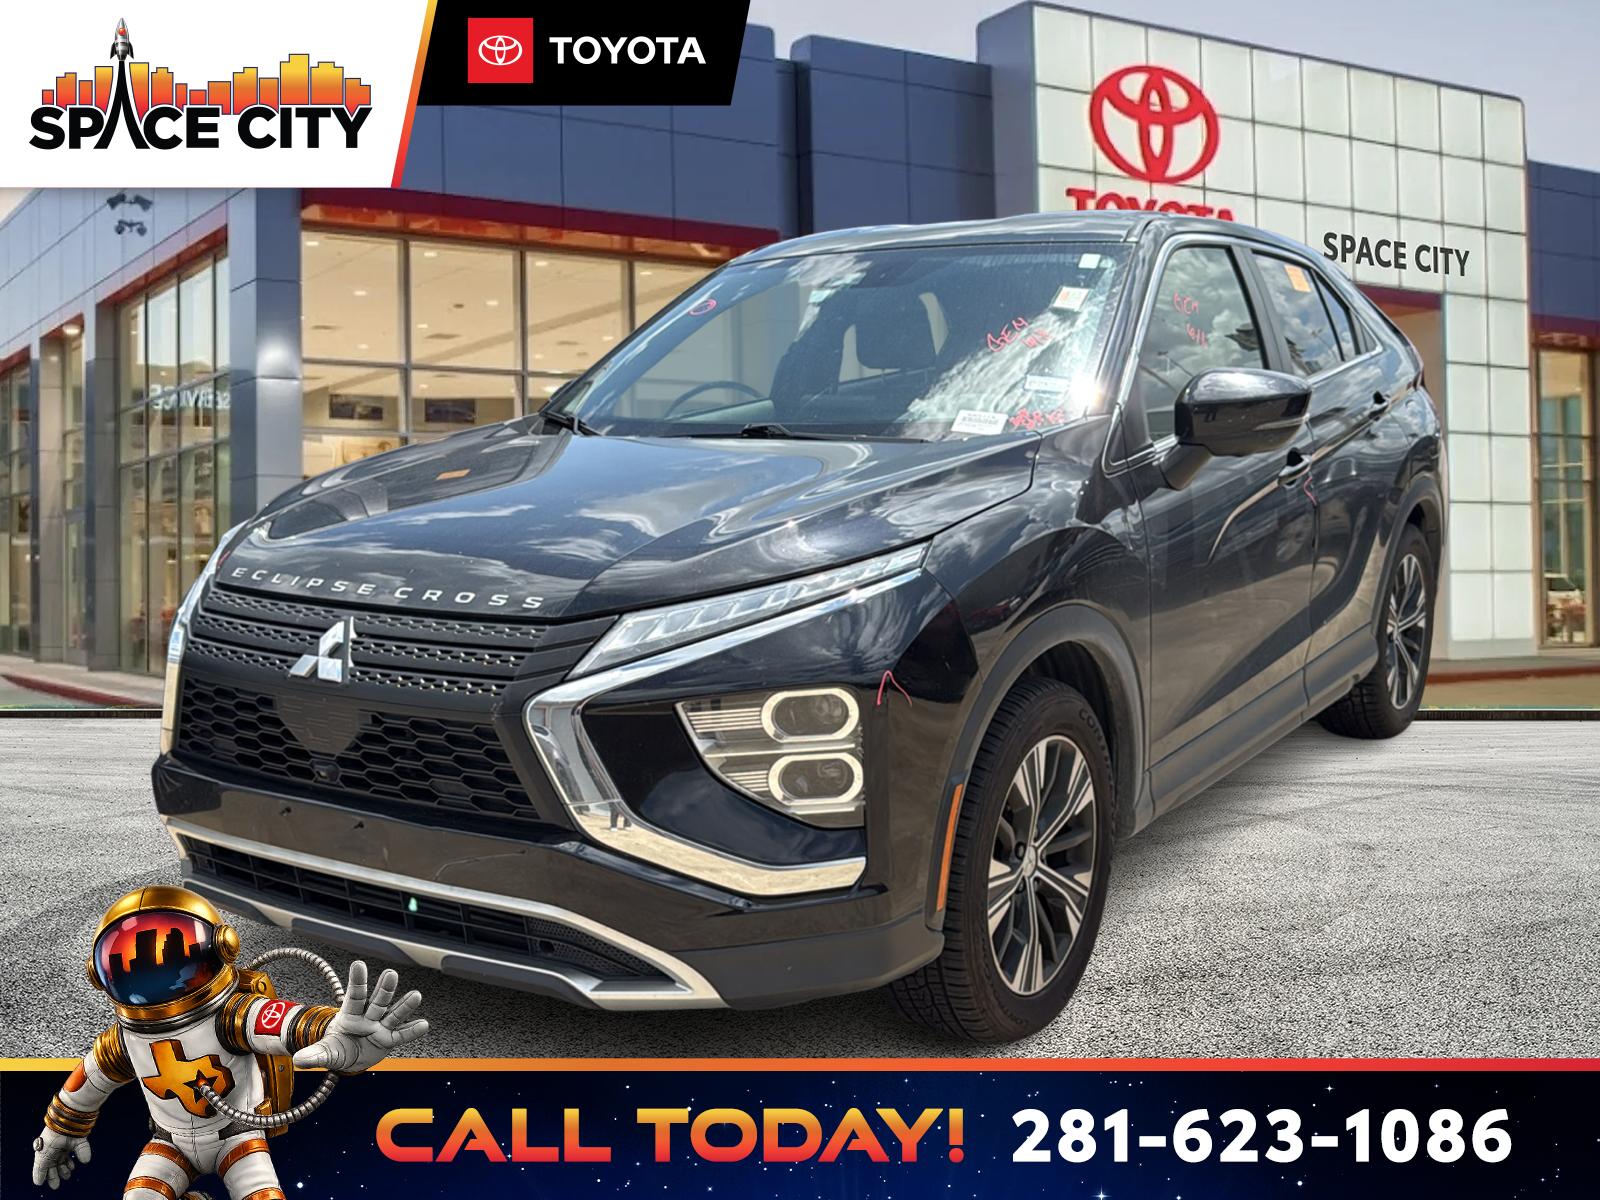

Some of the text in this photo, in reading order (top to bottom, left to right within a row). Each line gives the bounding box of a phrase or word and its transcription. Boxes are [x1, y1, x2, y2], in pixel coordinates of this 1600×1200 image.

[1322, 231, 1470, 277] SPACE CITY
[231, 567, 545, 610] ECLIPSE CROSS
